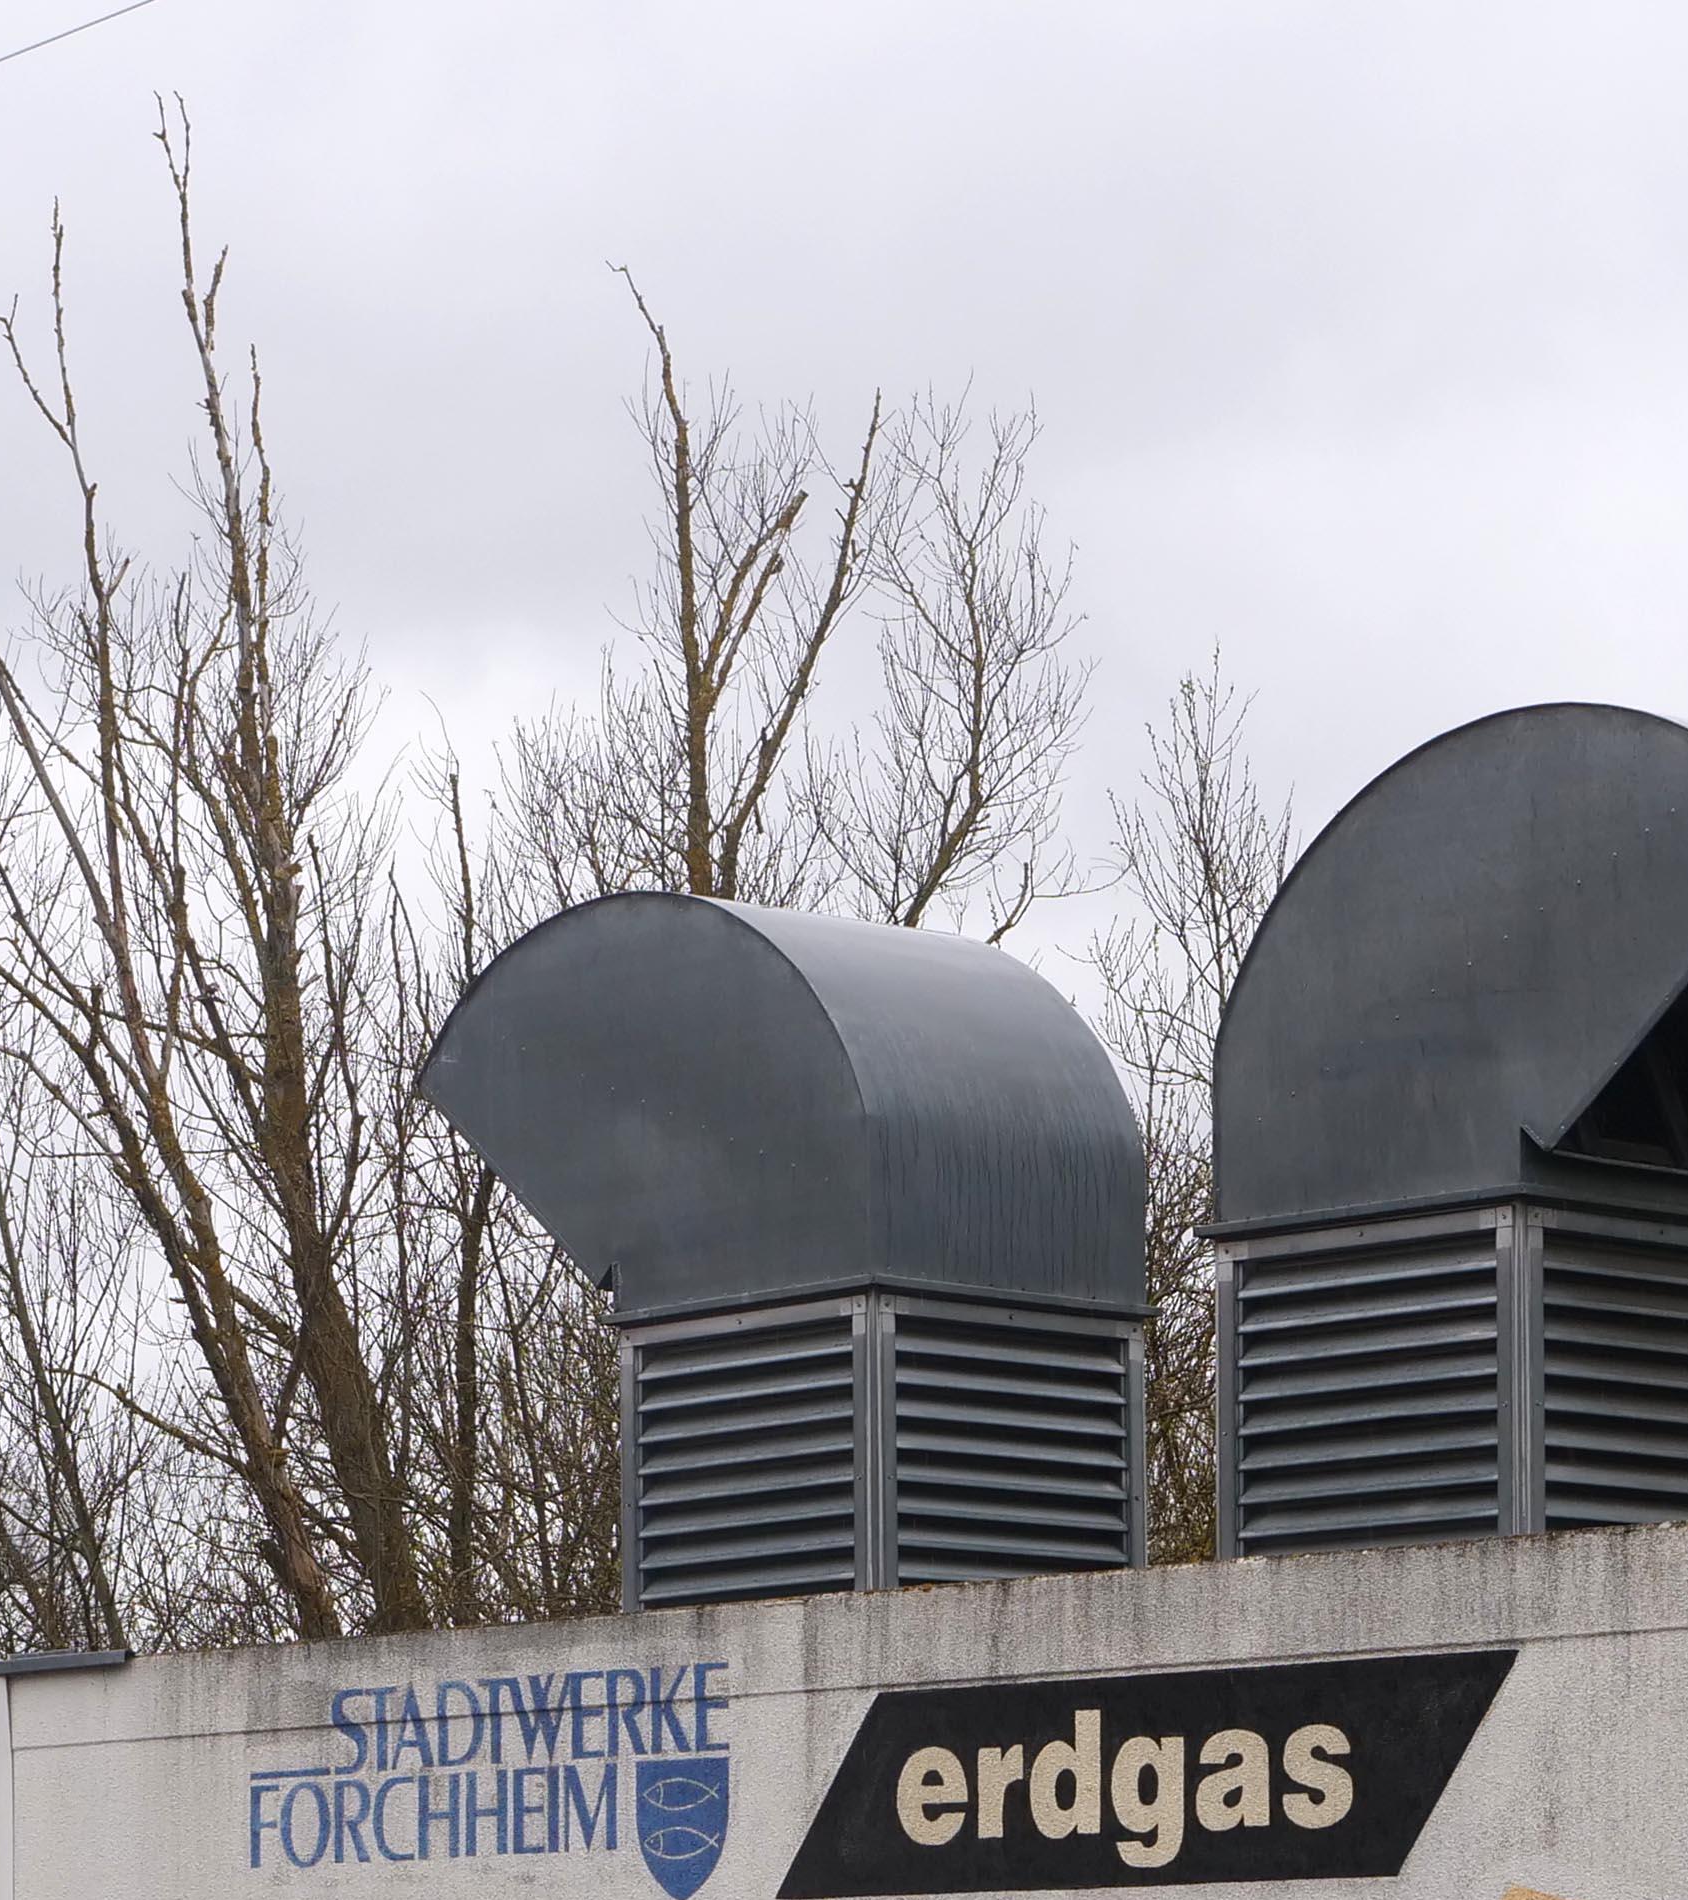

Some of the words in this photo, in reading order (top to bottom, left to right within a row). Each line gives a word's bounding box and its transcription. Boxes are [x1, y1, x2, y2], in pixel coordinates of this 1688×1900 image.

[330, 1661, 730, 1775] STADTWERKE
[249, 1763, 618, 1869] FORCHHEIM
[896, 1708, 1354, 1869] erdgas
